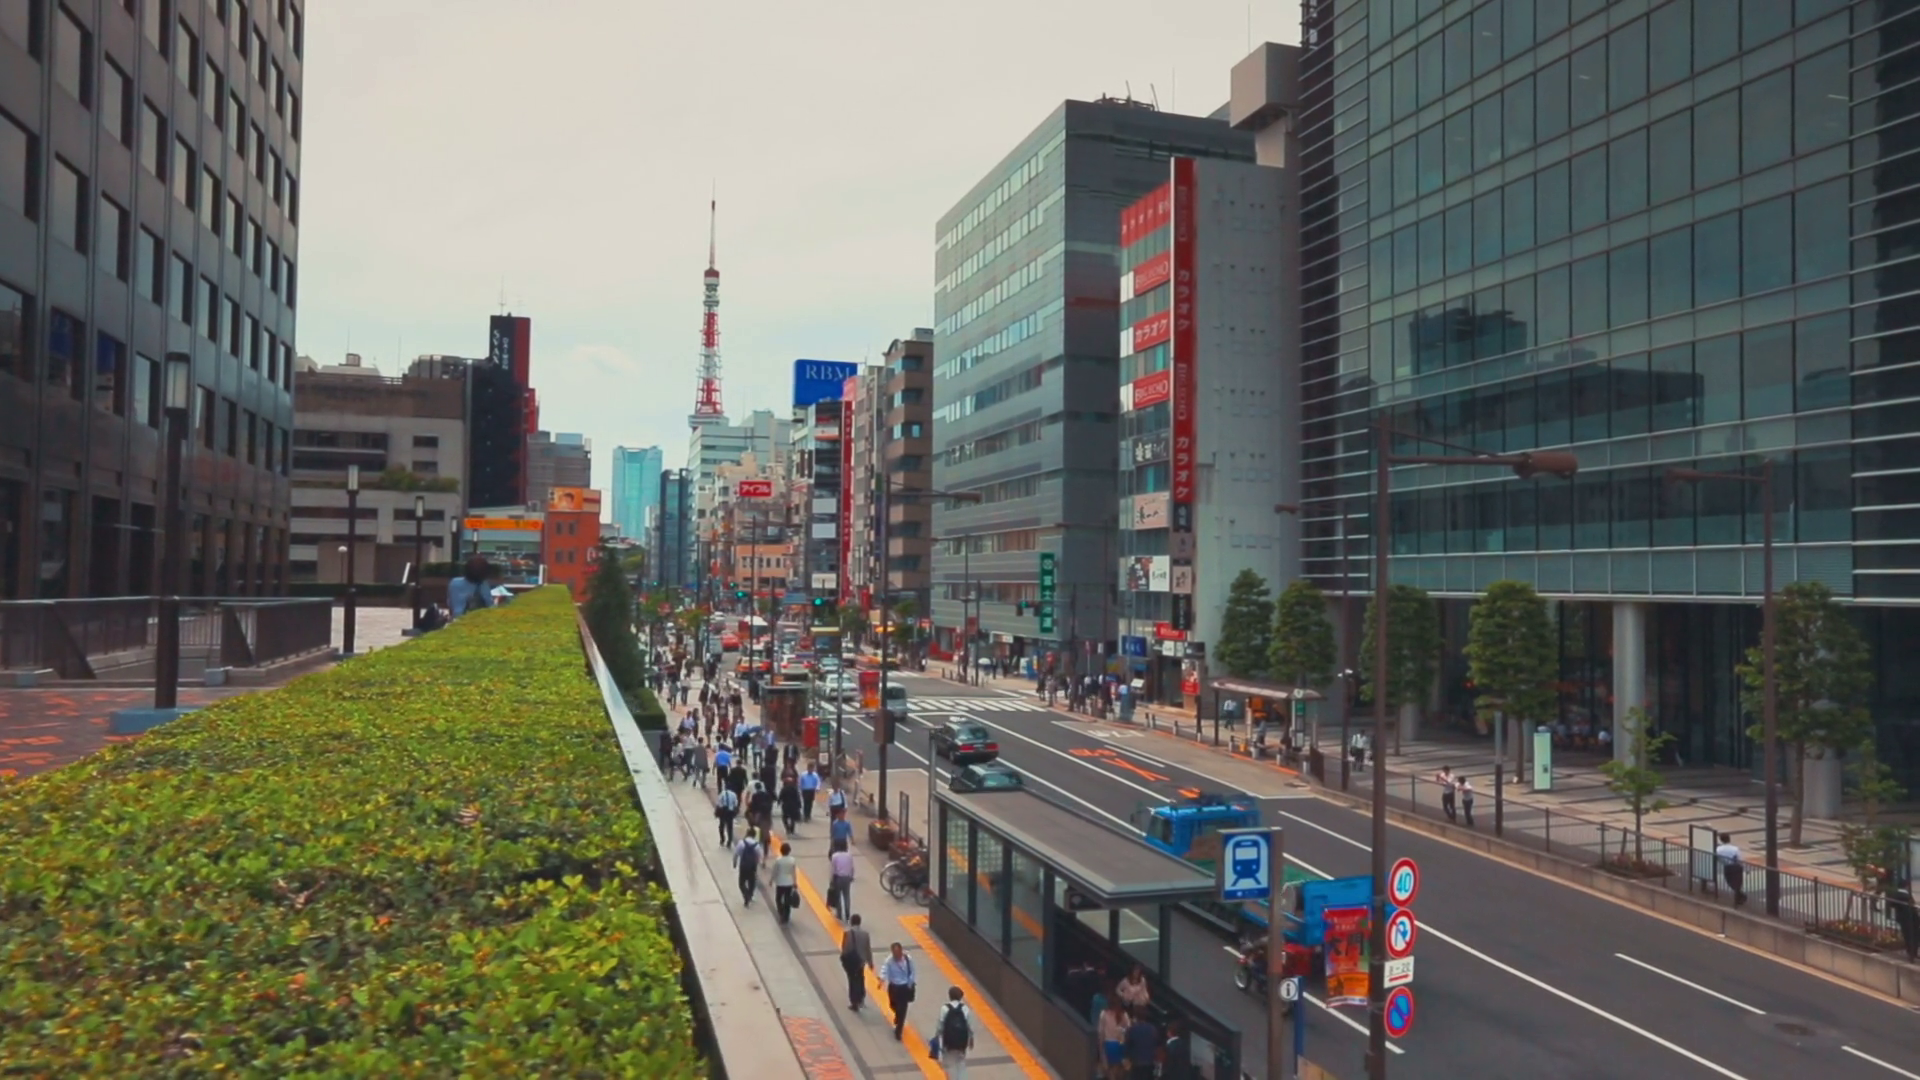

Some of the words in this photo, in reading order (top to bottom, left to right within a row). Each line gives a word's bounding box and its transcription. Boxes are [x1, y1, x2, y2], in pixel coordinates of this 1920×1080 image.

[1135, 319, 1168, 343] カラオケ
[1176, 437, 1190, 499] カラオケ
[1396, 872, 1411, 893] 40
